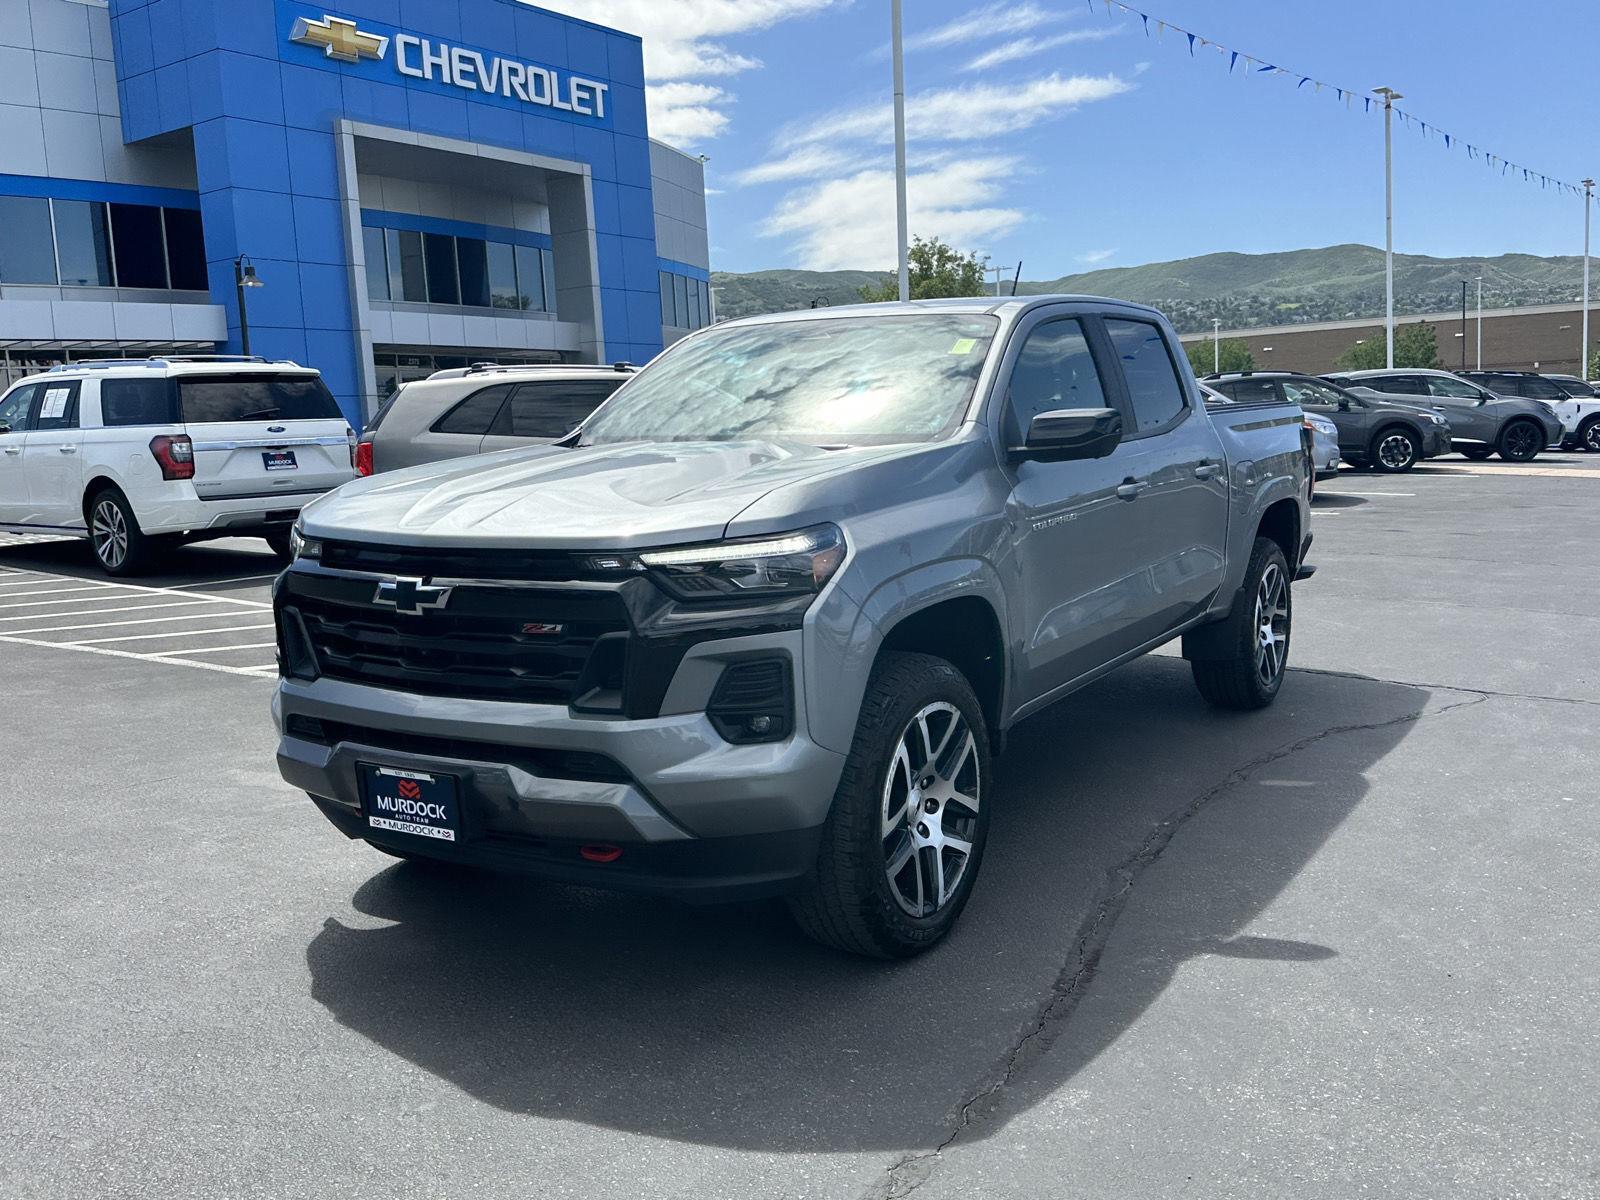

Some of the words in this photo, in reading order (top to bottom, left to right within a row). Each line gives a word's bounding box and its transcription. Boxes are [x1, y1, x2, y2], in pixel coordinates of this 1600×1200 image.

[395, 33, 609, 118] CHEVROLET
[1032, 513, 1078, 531] COLORADO
[521, 623, 564, 634] Z71
[376, 795, 447, 820] MURDOCK
[395, 813, 410, 821] AUTO
[413, 816, 429, 824] TEAM
[389, 820, 435, 836] MURDOCK
